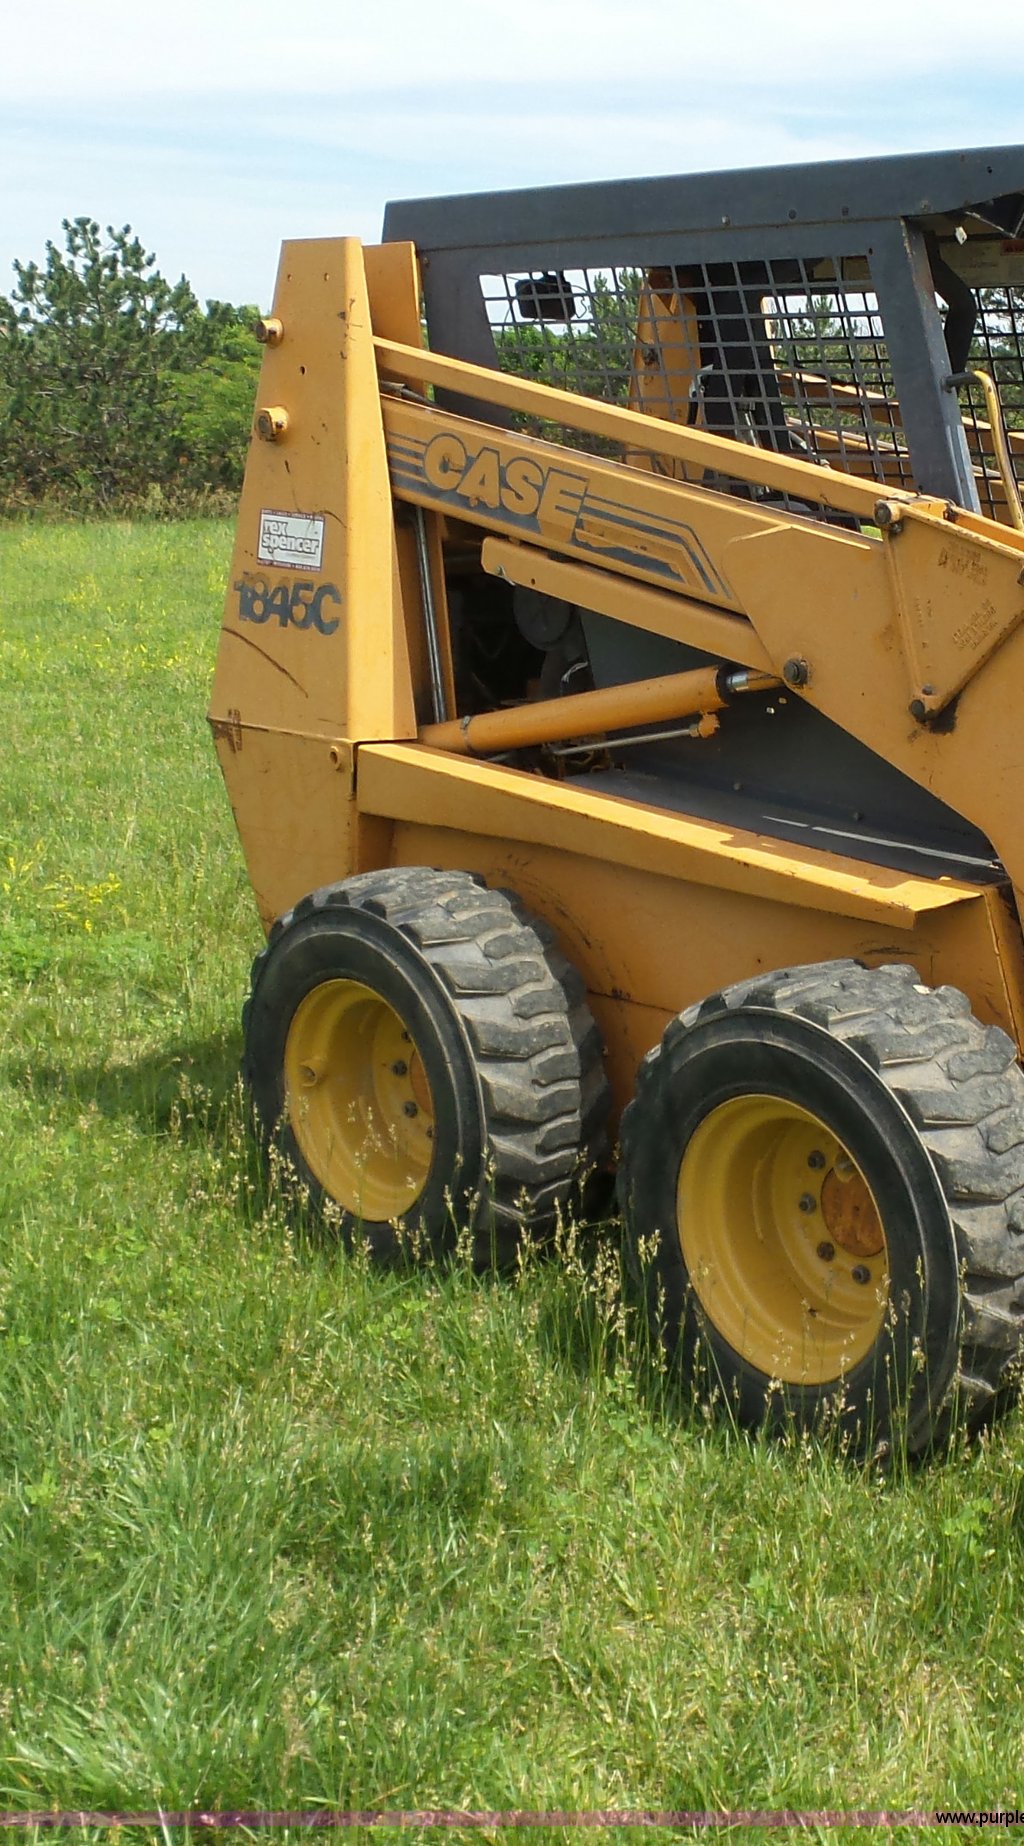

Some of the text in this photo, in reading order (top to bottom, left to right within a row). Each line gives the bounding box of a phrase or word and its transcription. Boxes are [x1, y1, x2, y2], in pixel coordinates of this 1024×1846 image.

[424, 432, 590, 543] CASE
[262, 533, 319, 554] spencer
[263, 520, 288, 535] rex
[234, 574, 342, 636] 1845C
